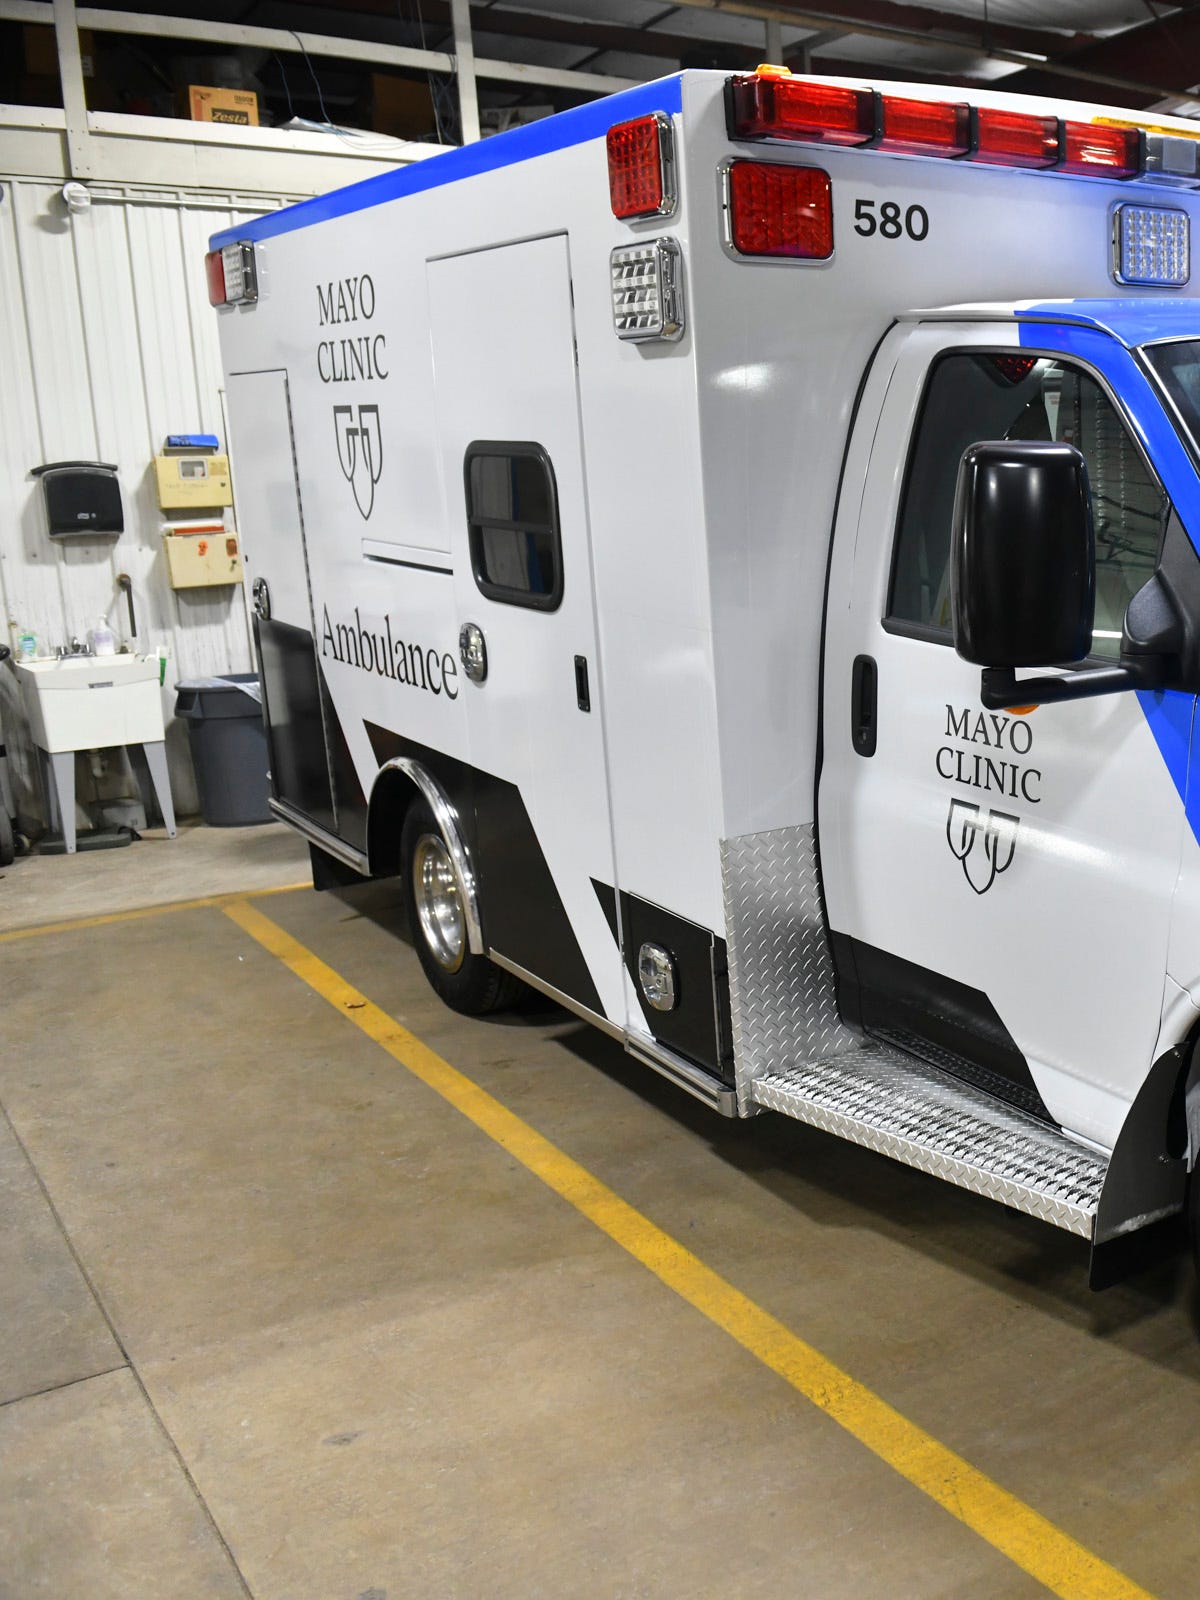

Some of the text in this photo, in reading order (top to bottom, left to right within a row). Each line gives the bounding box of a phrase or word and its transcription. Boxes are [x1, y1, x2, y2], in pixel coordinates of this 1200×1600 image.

[213, 111, 248, 124] Zesta
[853, 198, 930, 242] 580
[316, 273, 375, 326] MAYO
[317, 334, 389, 384] CLINIC
[322, 601, 459, 700] Ambulance
[944, 704, 1033, 755] MAYO
[935, 746, 1042, 804] CLINIC
